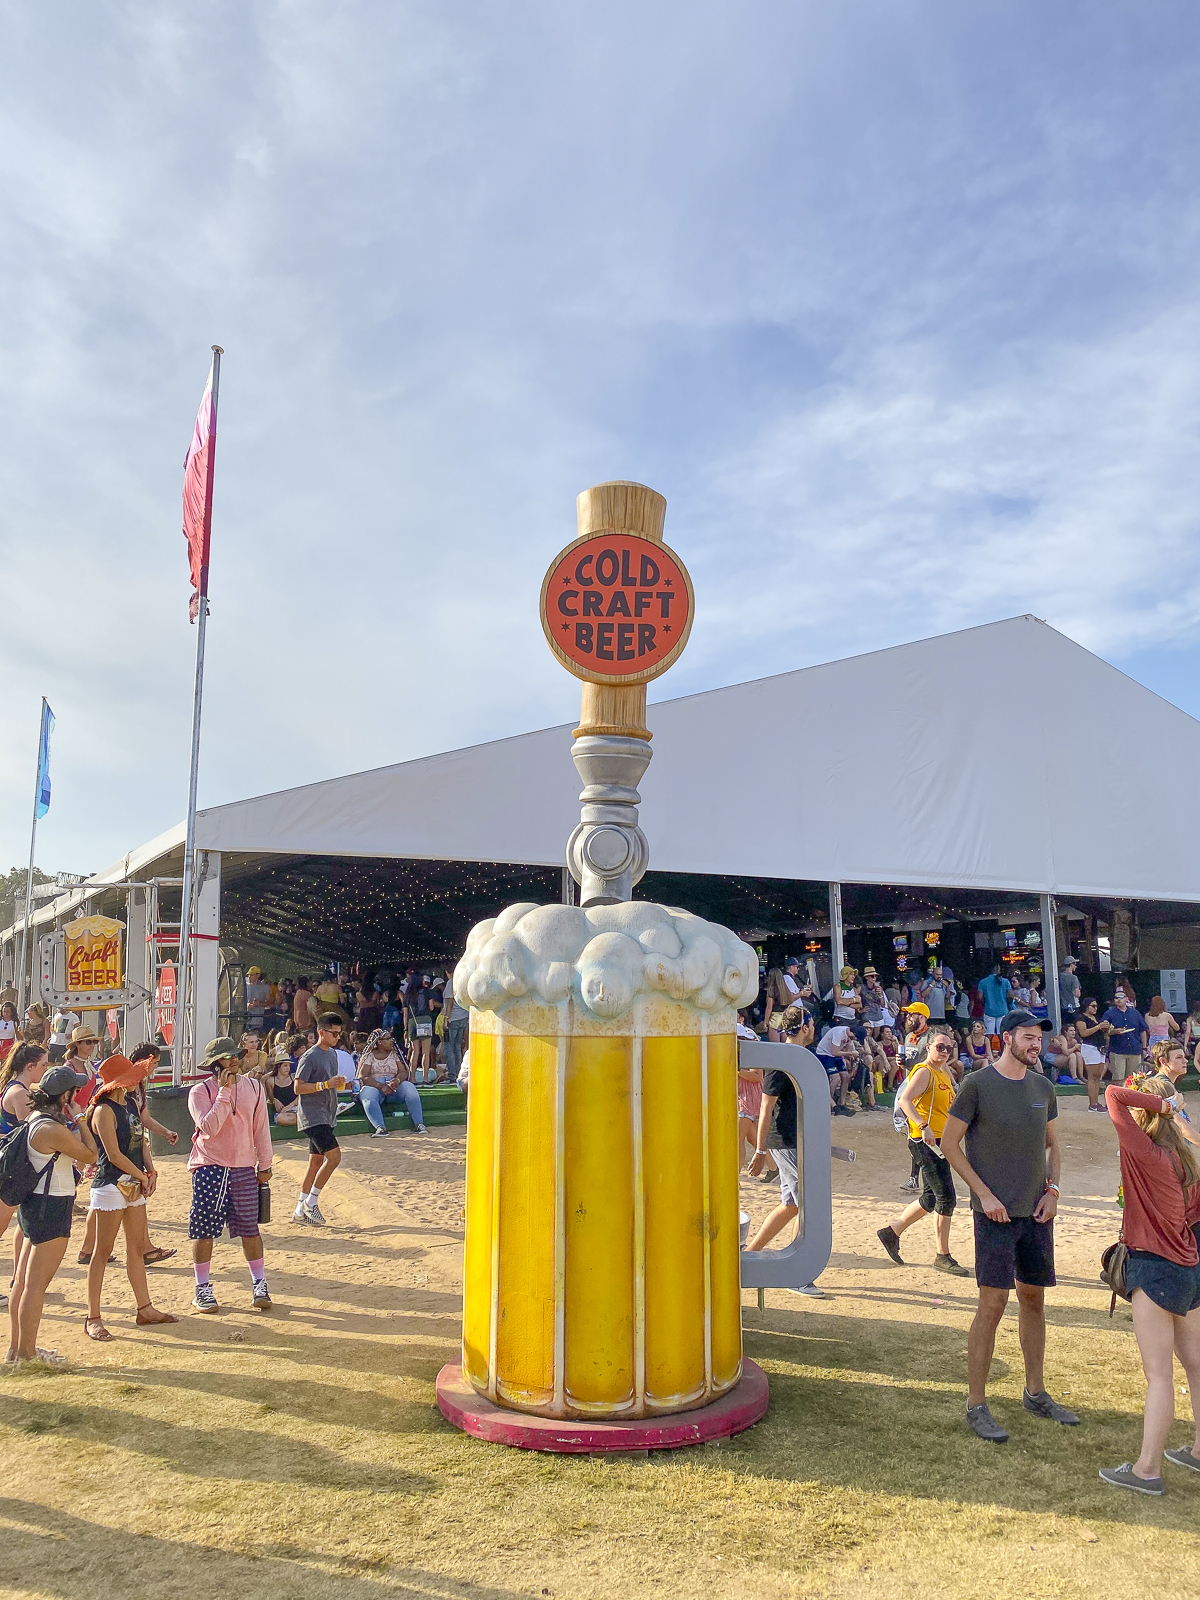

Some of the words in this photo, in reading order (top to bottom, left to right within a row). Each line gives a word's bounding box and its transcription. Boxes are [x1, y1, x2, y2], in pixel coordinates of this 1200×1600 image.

[575, 549, 660, 587] COLD
[558, 590, 675, 618] CRAFT
[575, 622, 657, 661] BEER
[68, 941, 119, 970] Craft
[69, 970, 118, 986] BEER
